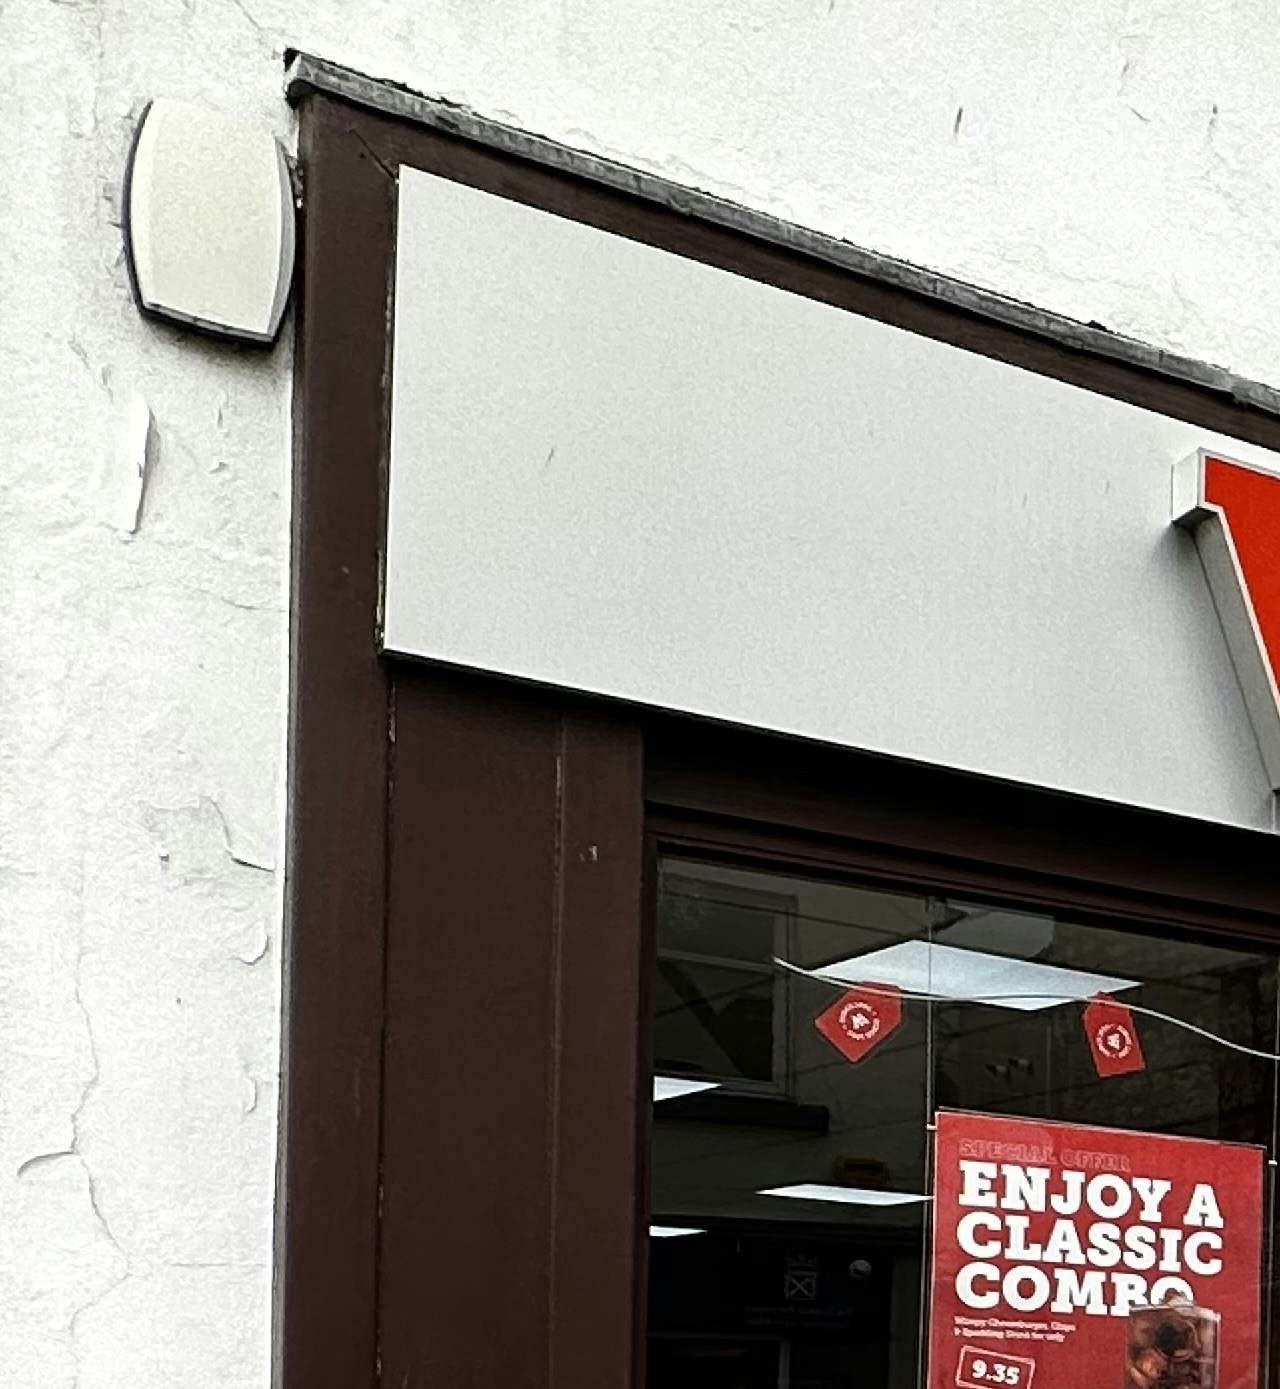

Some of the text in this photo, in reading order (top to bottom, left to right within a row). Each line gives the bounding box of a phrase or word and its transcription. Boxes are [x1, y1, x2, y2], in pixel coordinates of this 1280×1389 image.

[959, 1139, 1131, 1172] SPECIAL OFFER
[958, 1160, 1224, 1229] ENJOY A
[955, 1212, 1223, 1275] CLASSIC
[971, 1359, 1020, 1385] 9.35
